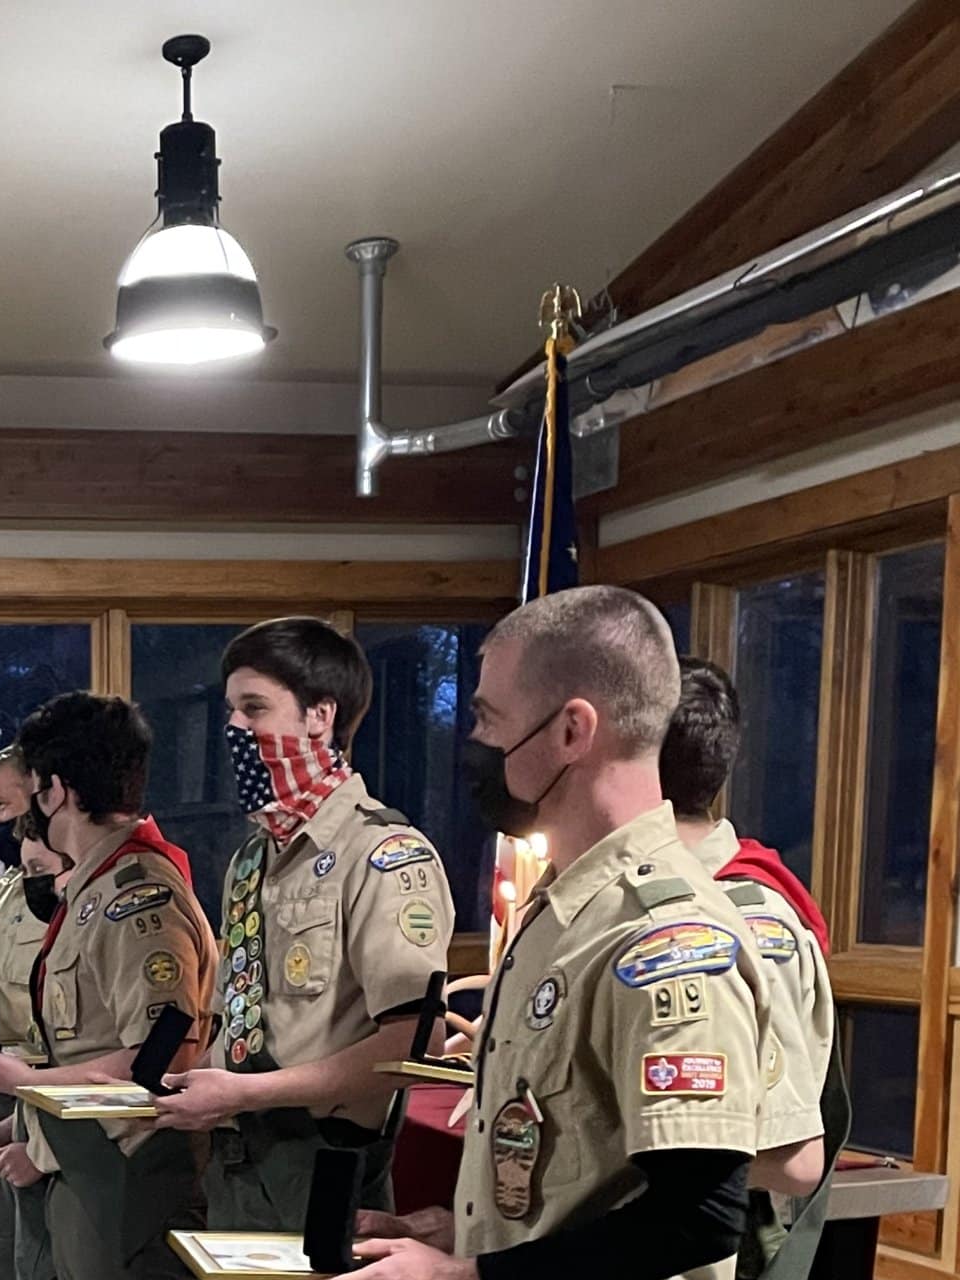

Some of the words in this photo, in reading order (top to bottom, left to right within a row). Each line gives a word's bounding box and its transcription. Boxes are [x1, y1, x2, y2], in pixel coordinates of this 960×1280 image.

[399, 868, 427, 891] 99
[135, 913, 163, 934] 99
[655, 982, 701, 1018] 99
